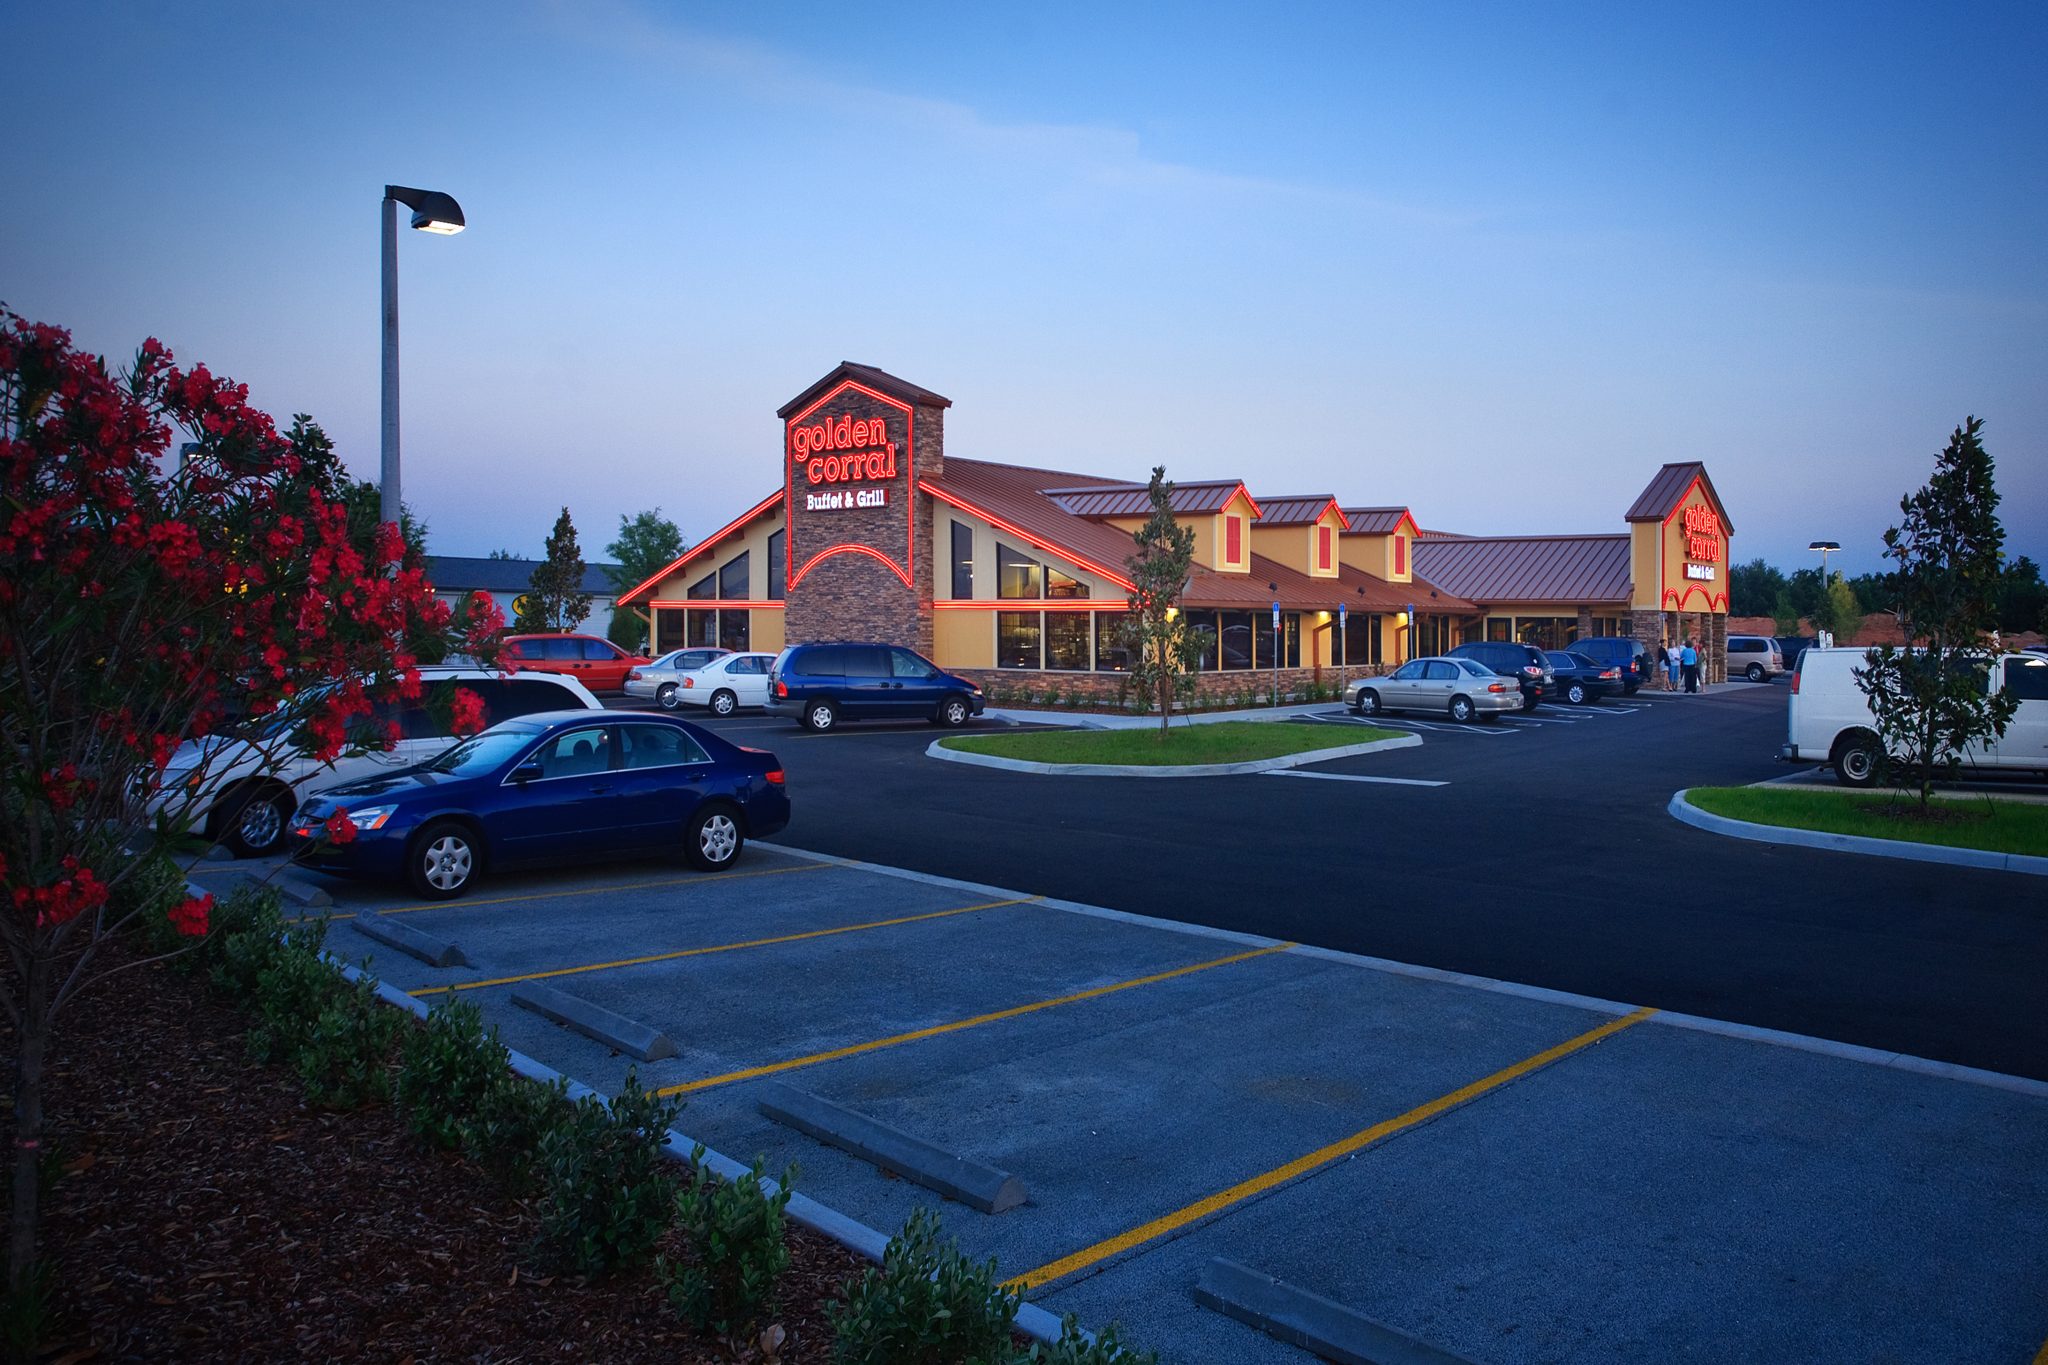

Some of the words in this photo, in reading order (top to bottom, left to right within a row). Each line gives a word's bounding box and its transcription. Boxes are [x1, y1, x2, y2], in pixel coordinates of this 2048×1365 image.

[794, 415, 886, 462] golden
[808, 443, 896, 484] corral
[806, 492, 842, 510] Buffet
[844, 491, 854, 508] &
[856, 489, 885, 507] Grill
[1685, 504, 1717, 538] golden
[1690, 535, 1720, 562] corral
